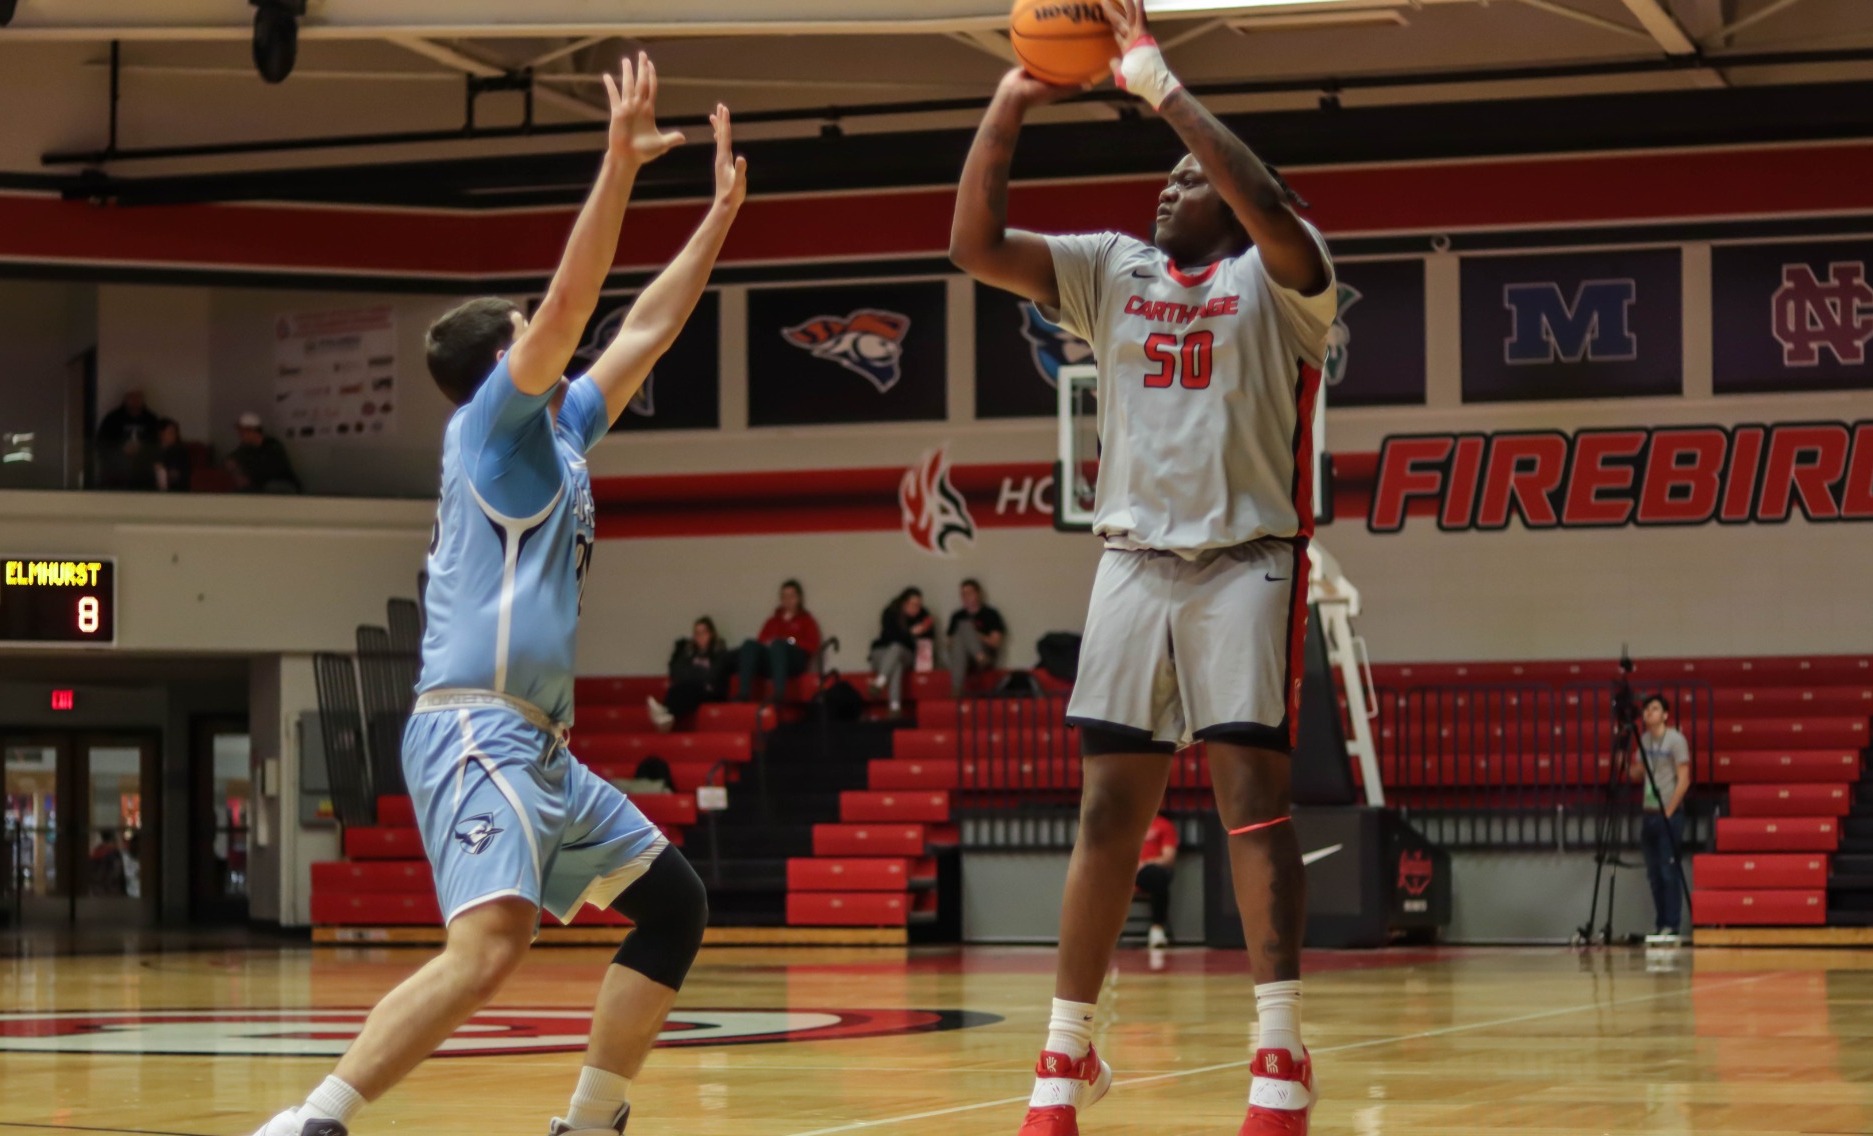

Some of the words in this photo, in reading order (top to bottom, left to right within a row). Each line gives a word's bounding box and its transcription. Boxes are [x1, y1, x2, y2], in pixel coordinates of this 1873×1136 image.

[1503, 279, 1637, 365] M
[1144, 330, 1214, 390] 50
[995, 475, 1055, 515] HO
[5, 561, 101, 586] ELMHURST
[78, 596, 99, 633] 8
